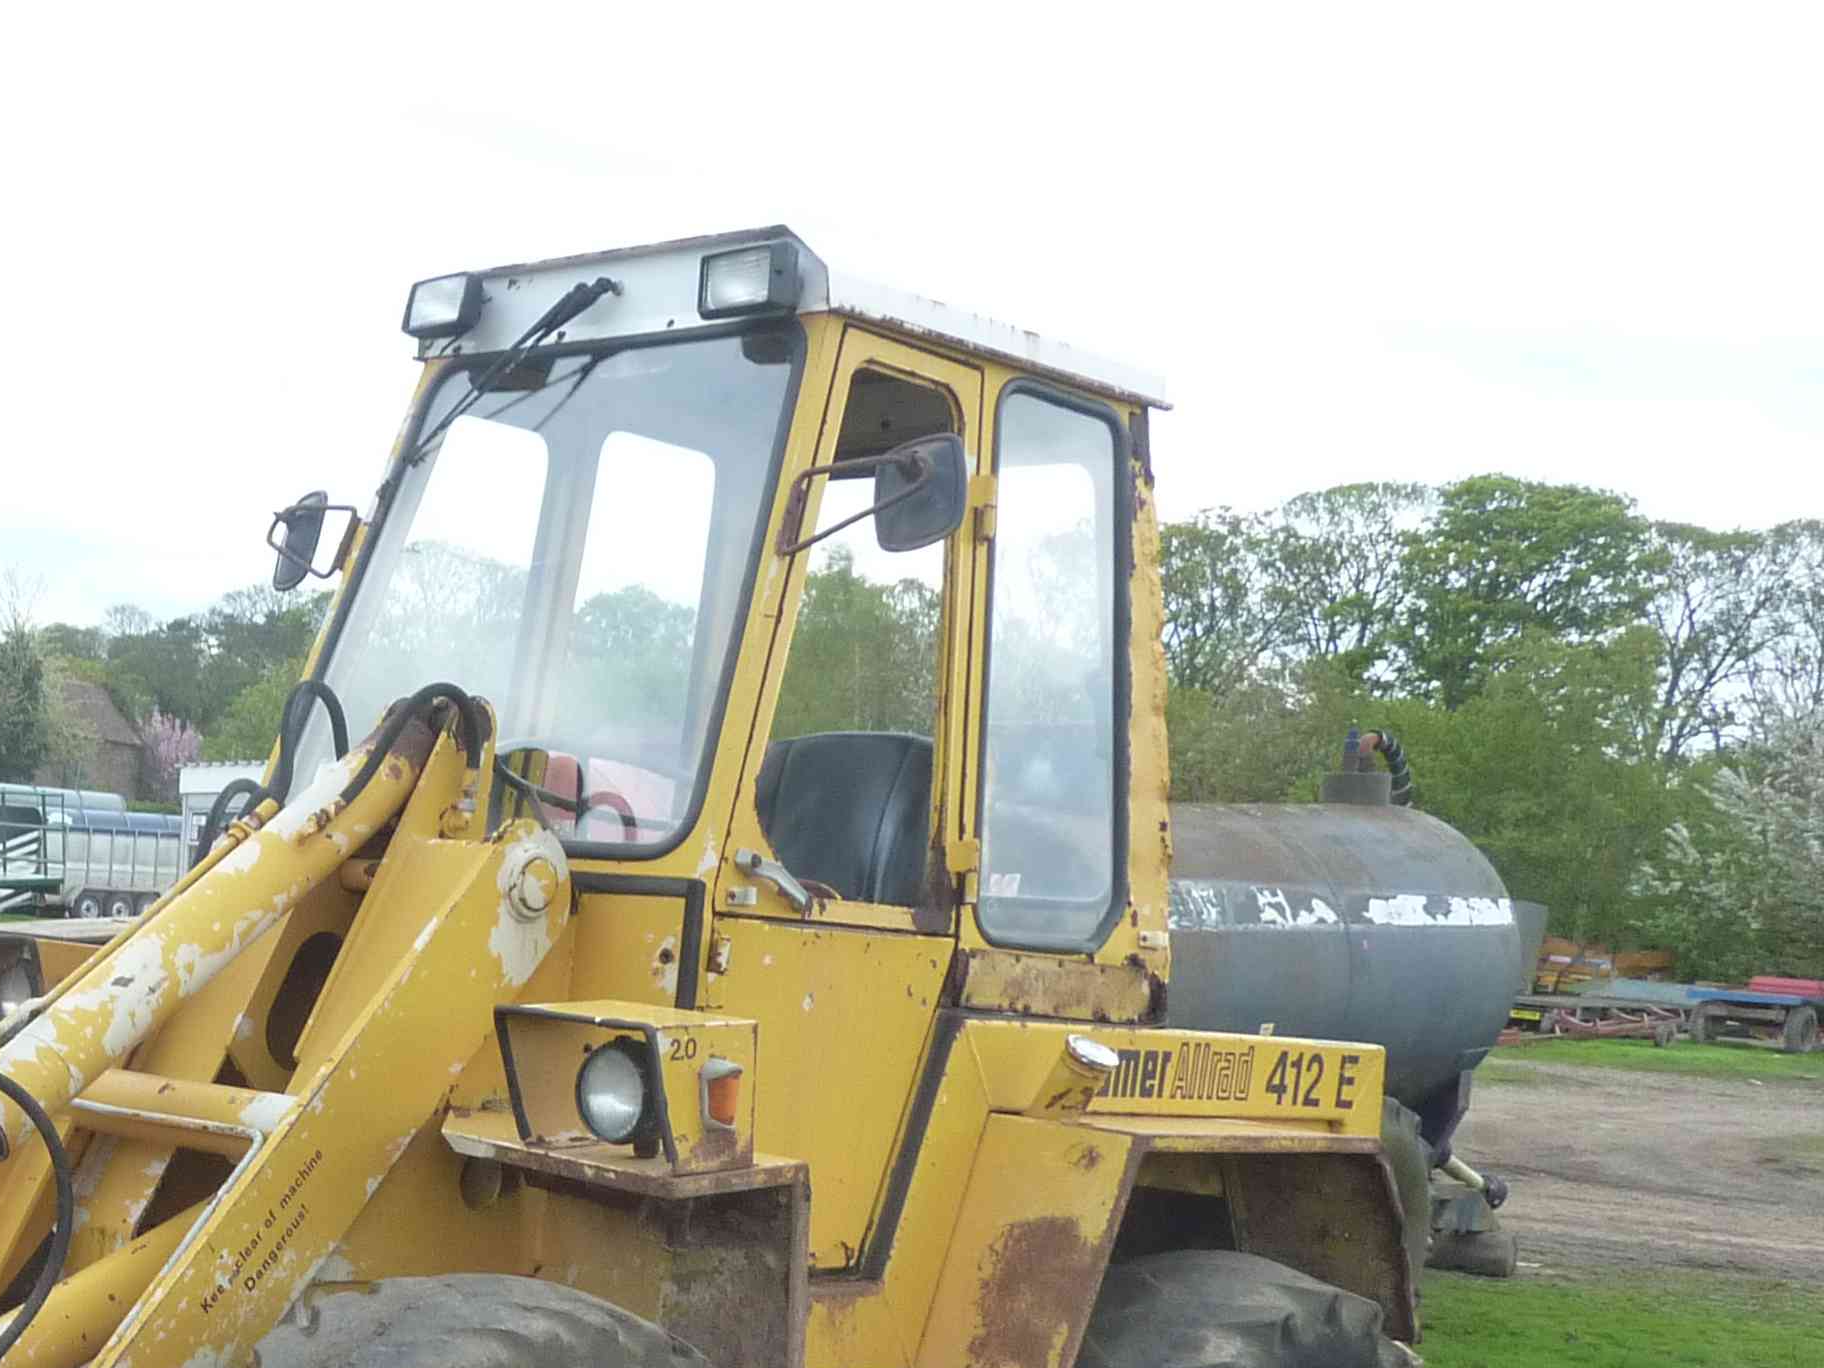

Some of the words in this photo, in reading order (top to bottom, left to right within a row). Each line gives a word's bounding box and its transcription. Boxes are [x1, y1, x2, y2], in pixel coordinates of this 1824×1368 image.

[1170, 1041, 1255, 1101] Allrad
[1265, 1051, 1325, 1107] 412
[1335, 1055, 1360, 1109] E
[236, 1231, 263, 1271] clear
[264, 1210, 277, 1229] of
[280, 1150, 323, 1210] machine
[243, 1203, 309, 1292] Dangerous!
